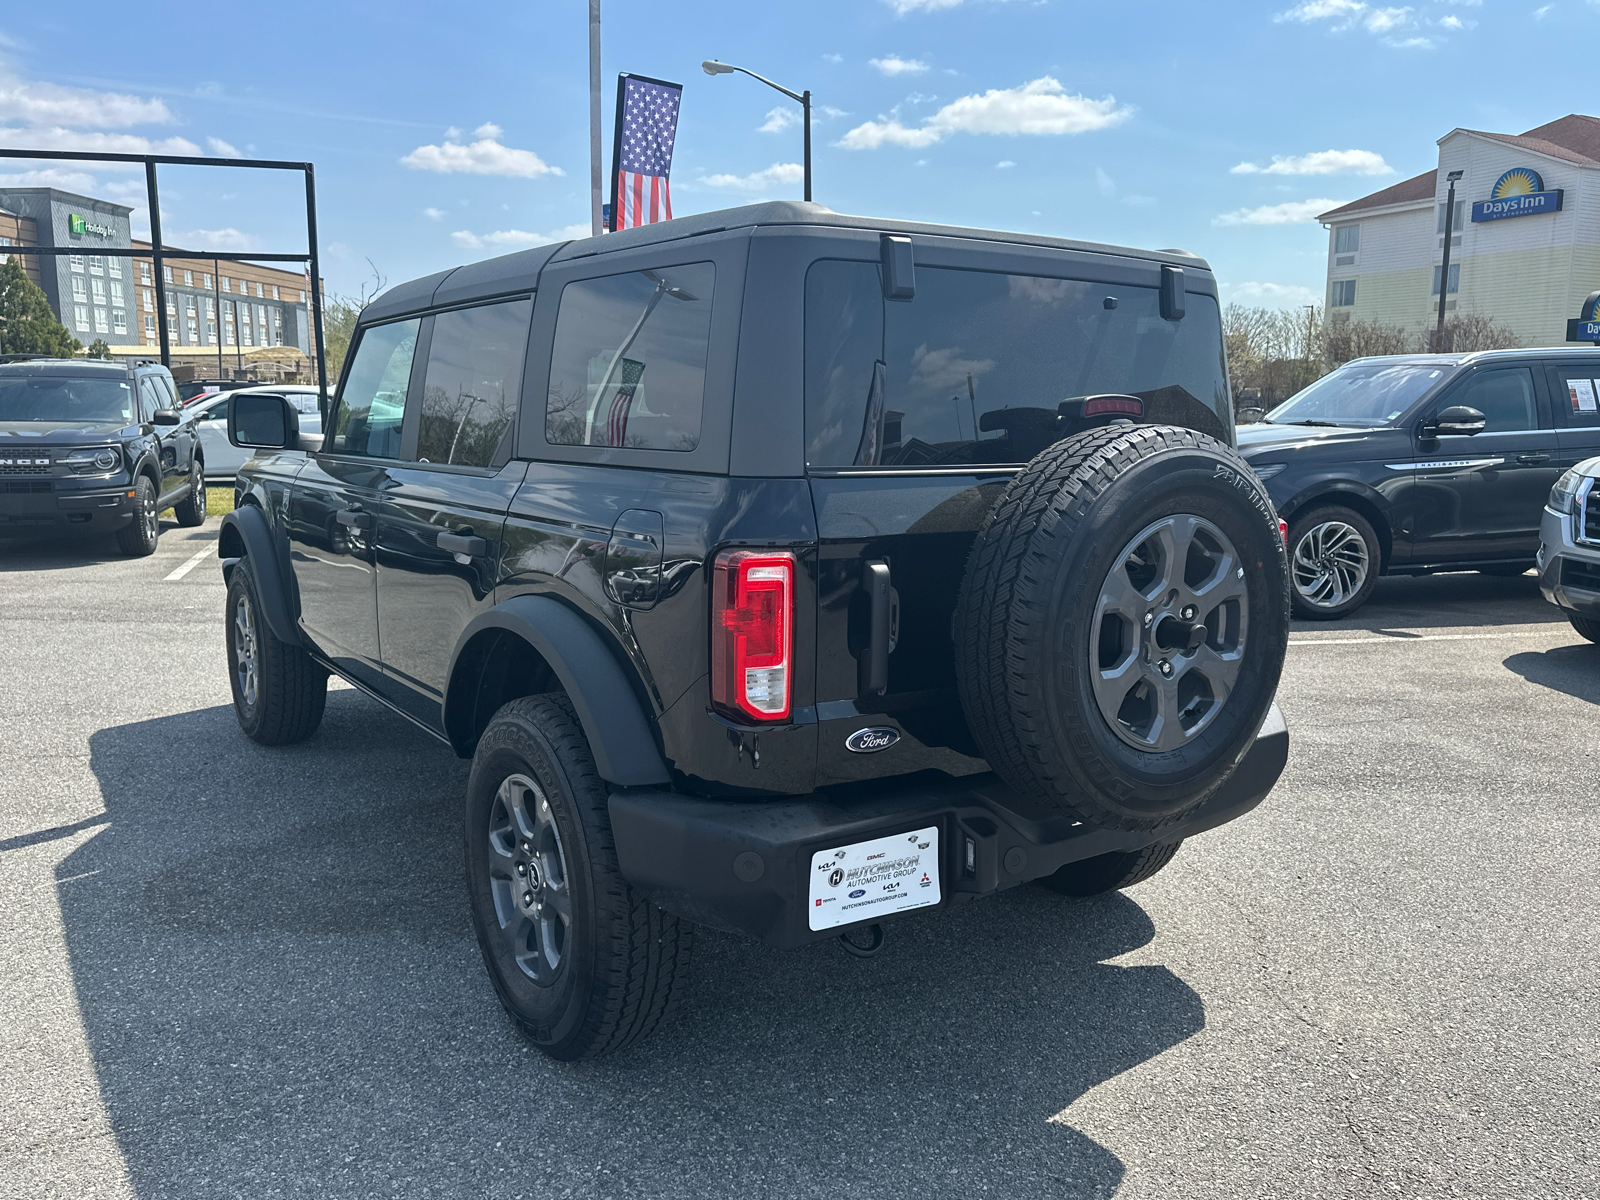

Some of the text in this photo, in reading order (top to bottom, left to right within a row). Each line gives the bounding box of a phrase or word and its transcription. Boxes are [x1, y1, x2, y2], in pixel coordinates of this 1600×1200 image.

[1483, 196, 1545, 214] Days Inn
[1502, 209, 1533, 218] WYNDHAM
[85, 221, 117, 237] Holiday Inn
[860, 732, 889, 748] Ford
[867, 853, 885, 861] GMC
[846, 855, 920, 881] HUTCHINSON
[847, 867, 917, 888] AUTOMOTIVE GROUP
[841, 892, 908, 911] HUTCHINSONAUTOGROUP.COM
